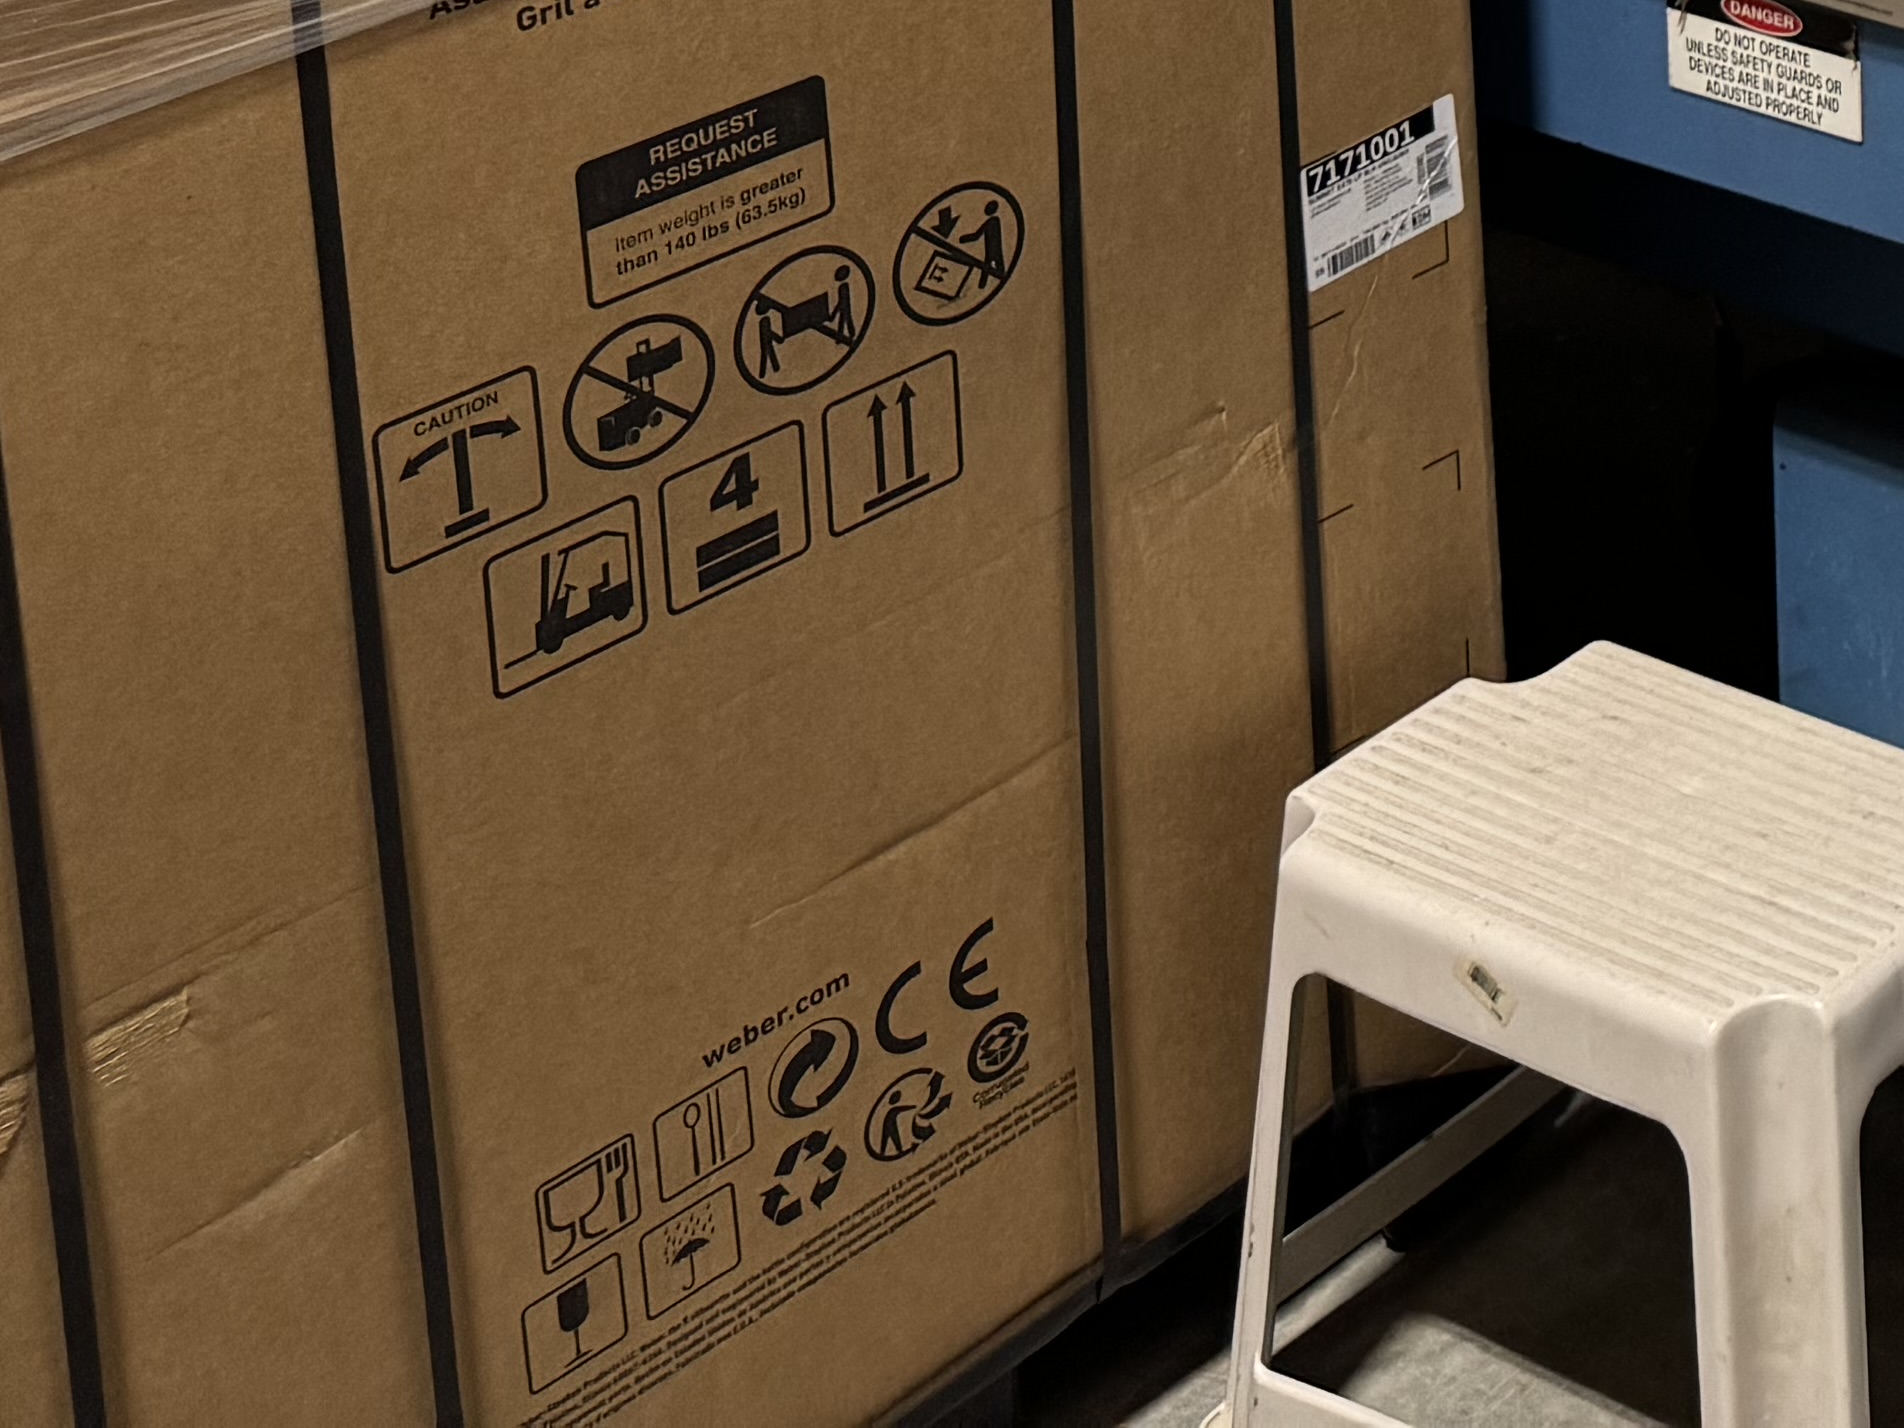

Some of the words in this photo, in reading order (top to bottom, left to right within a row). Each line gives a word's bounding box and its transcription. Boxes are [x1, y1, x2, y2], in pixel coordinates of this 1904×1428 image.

[1730, 0, 1795, 30] DANGER
[1686, 37, 1728, 63] UNLESS
[1731, 51, 1773, 75] SAFETY
[1776, 64, 1822, 90] GUARDS
[1825, 78, 1842, 96] OR
[1715, 27, 1730, 43] DO
[1734, 33, 1755, 52] NOT
[1760, 40, 1811, 68] OPERATE
[1689, 56, 1735, 82] DEVICES
[1738, 71, 1760, 89] ARE
[1763, 79, 1774, 94] IN
[1777, 83, 1813, 105] PLACE
[1816, 94, 1839, 113] AND
[1706, 80, 1762, 108] ADJUSTED
[1765, 96, 1824, 126] PROPERLY
[635, 127, 777, 198] ASSISTANCE
[649, 109, 758, 165] REQUEST
[1308, 120, 1415, 193] 7171001
[615, 229, 654, 253] Item
[659, 201, 716, 234] weight
[721, 195, 736, 210] is
[740, 168, 803, 205] greater
[616, 249, 658, 275] than
[665, 232, 697, 255] 140
[702, 220, 729, 241] lbs
[736, 187, 805, 230] (63.5kg)
[412, 391, 499, 438] CAUTION
[709, 453, 759, 512] 4
[702, 973, 850, 1068] weber.com
